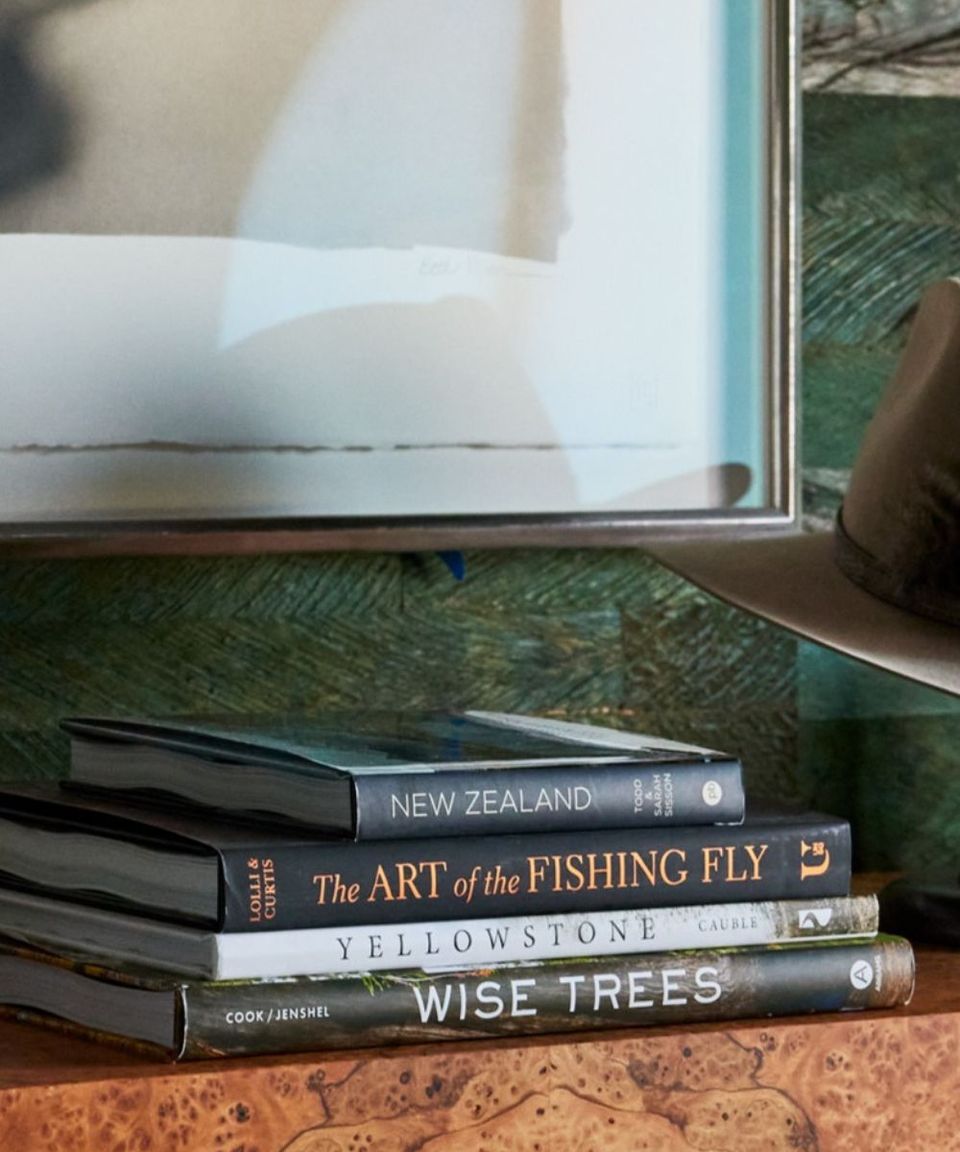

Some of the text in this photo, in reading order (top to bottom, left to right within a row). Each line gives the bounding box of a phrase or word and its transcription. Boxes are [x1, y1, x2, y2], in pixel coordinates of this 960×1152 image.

[391, 786, 592, 819] NEW ZEALAND
[633, 779, 643, 814] TODD
[653, 774, 663, 816] SARAH
[664, 773, 673, 817] SISSON
[247, 857, 261, 923] LOLLI &
[262, 858, 277, 920] CURTIS
[313, 844, 769, 905] The ART of the FISHING FLY
[336, 917, 657, 961] YELLOWSTONE
[698, 916, 759, 933] CAUBLE
[413, 966, 723, 1024] WISE TREES
